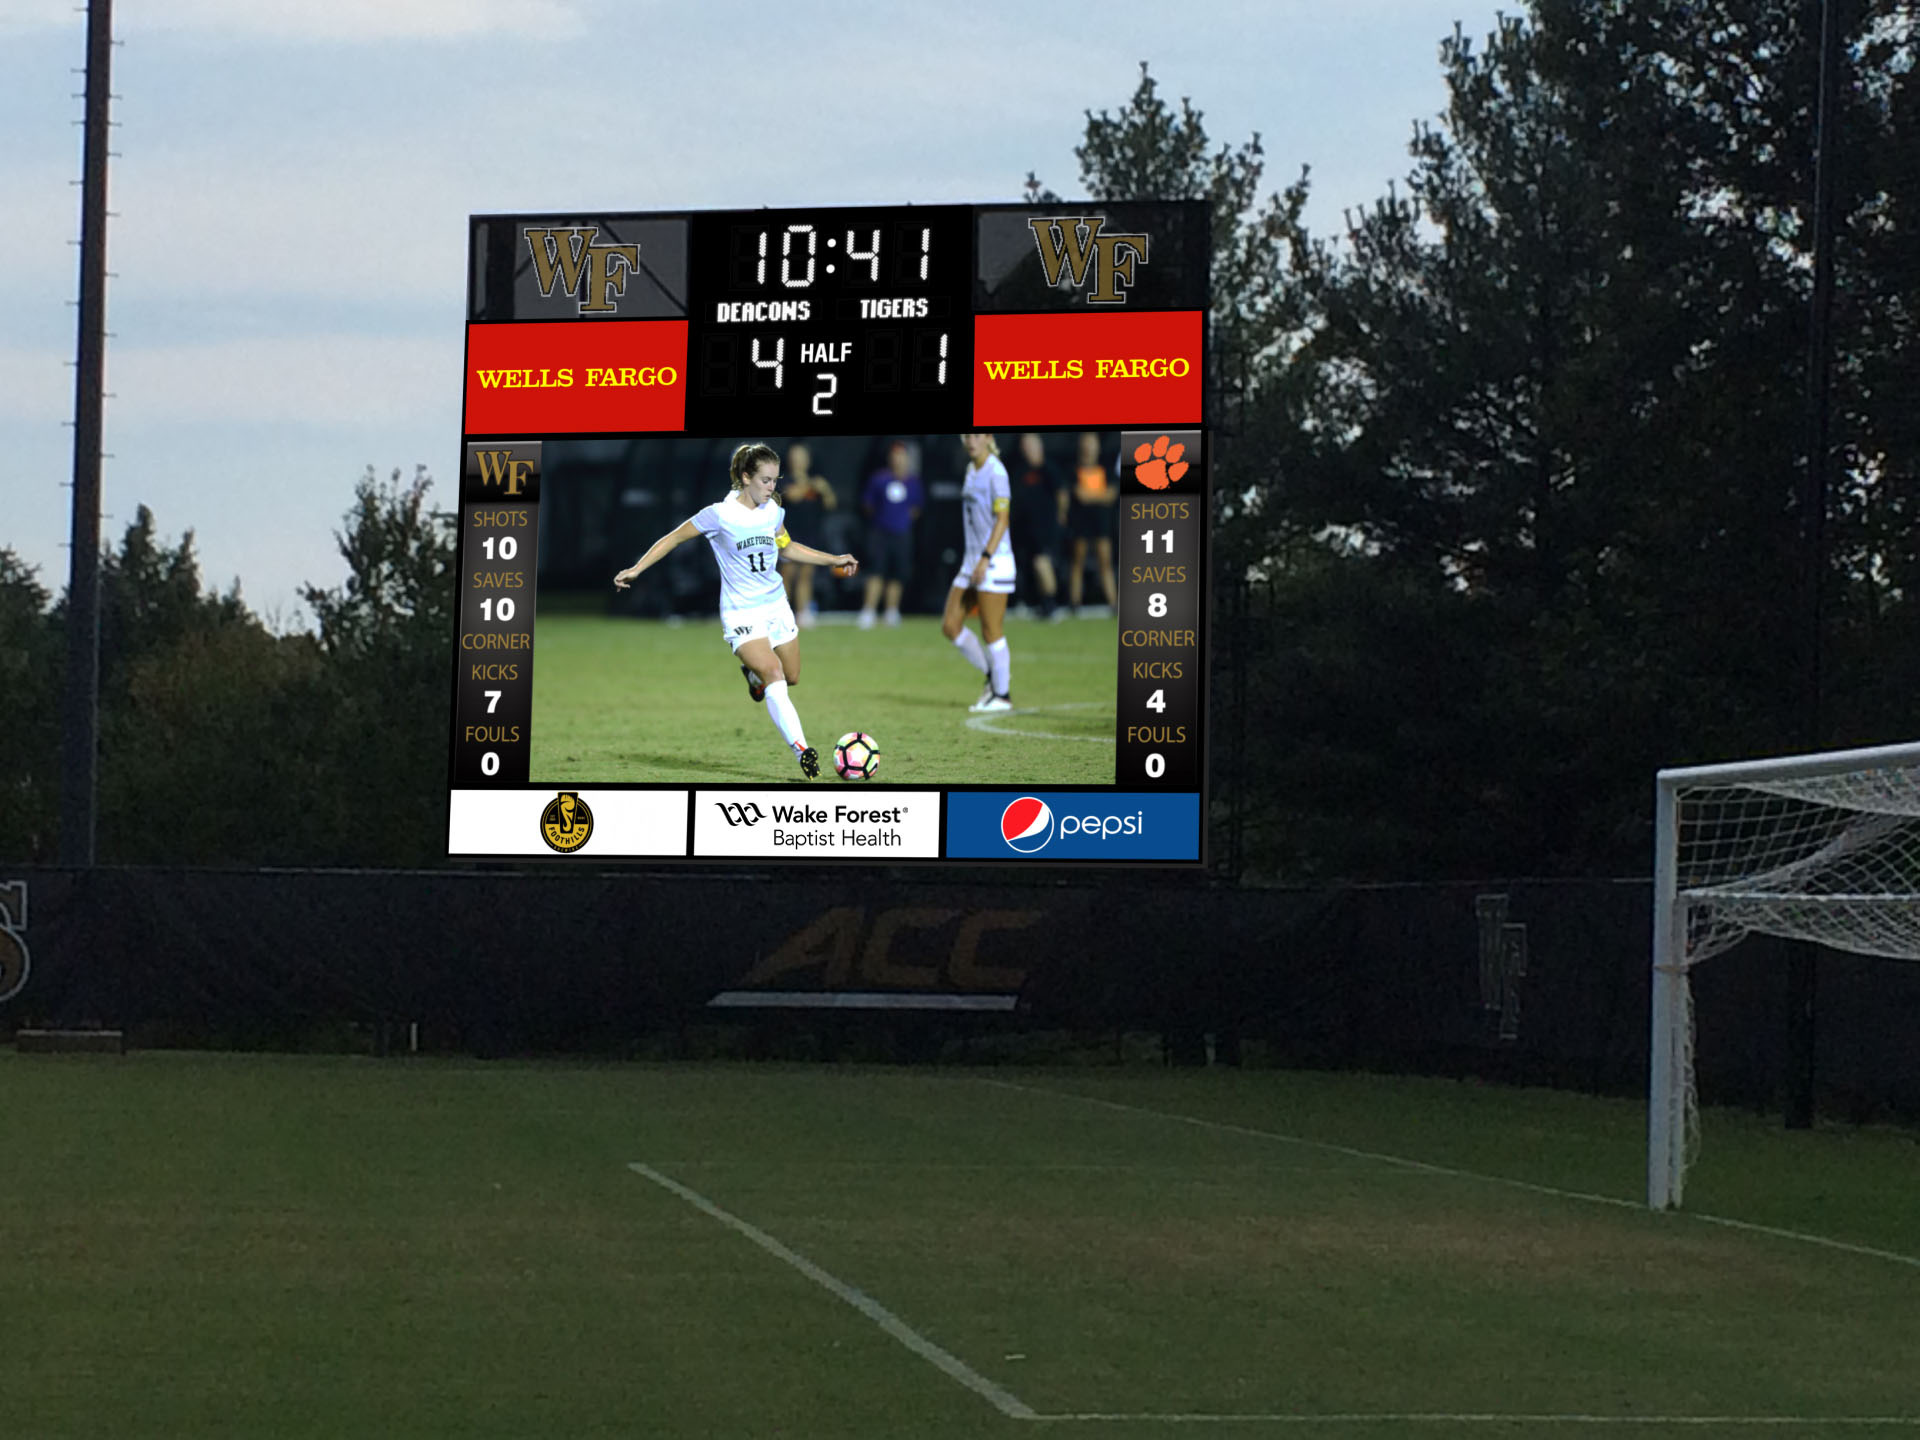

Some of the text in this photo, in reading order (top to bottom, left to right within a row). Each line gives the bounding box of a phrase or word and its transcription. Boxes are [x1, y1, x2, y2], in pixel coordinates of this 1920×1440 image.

[524, 226, 640, 314] WF
[1028, 216, 1149, 304] WF
[717, 301, 811, 323] DEACONS
[860, 298, 928, 319] TIGERS
[752, 338, 784, 389] 4
[800, 342, 852, 363] HALF
[937, 333, 948, 385] 1
[477, 366, 677, 388] WELLS FARGO
[984, 358, 1190, 380] WELLS FARGO
[812, 373, 837, 415] 2
[474, 451, 534, 495] WF
[473, 511, 528, 527] SHOTS
[1130, 503, 1190, 520] SHOTS
[482, 536, 518, 560] 10
[736, 537, 755, 551] WAKE
[1140, 529, 1174, 554] 11
[747, 552, 767, 573] 11
[472, 572, 524, 588] SAVES
[1131, 566, 1186, 583] SAVES
[479, 597, 515, 622] 10
[1147, 592, 1168, 618] 8
[462, 633, 530, 650] CORNER
[1121, 630, 1195, 647] CORNER
[471, 664, 518, 681] KICKS
[1132, 662, 1183, 679] KICKS
[484, 690, 502, 713] 7
[1146, 689, 1166, 713] 4
[465, 726, 520, 743] FOULS
[1127, 726, 1186, 743] FOULS
[481, 752, 500, 776] 0
[1144, 753, 1166, 778] 0
[772, 804, 828, 824] Wake
[1060, 810, 1143, 840] pepsi
[548, 826, 585, 845] FOOTHILLS
[773, 828, 902, 850] Baptist Health
[742, 906, 1046, 988] ACC
